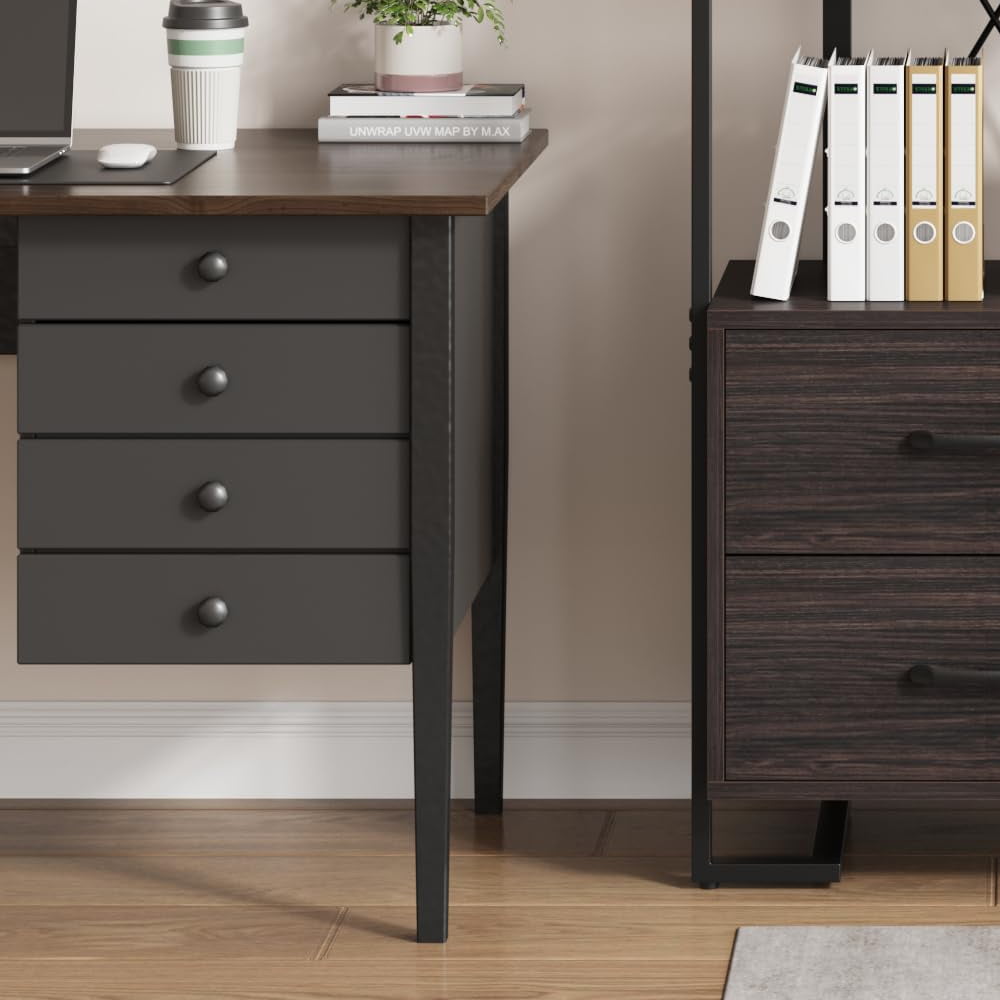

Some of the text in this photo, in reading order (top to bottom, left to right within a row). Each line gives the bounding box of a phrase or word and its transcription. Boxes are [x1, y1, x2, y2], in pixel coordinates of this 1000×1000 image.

[349, 126, 401, 137] UNWRAP
[404, 126, 432, 137] UVW
[434, 126, 459, 137] MAP
[463, 126, 478, 137] BY
